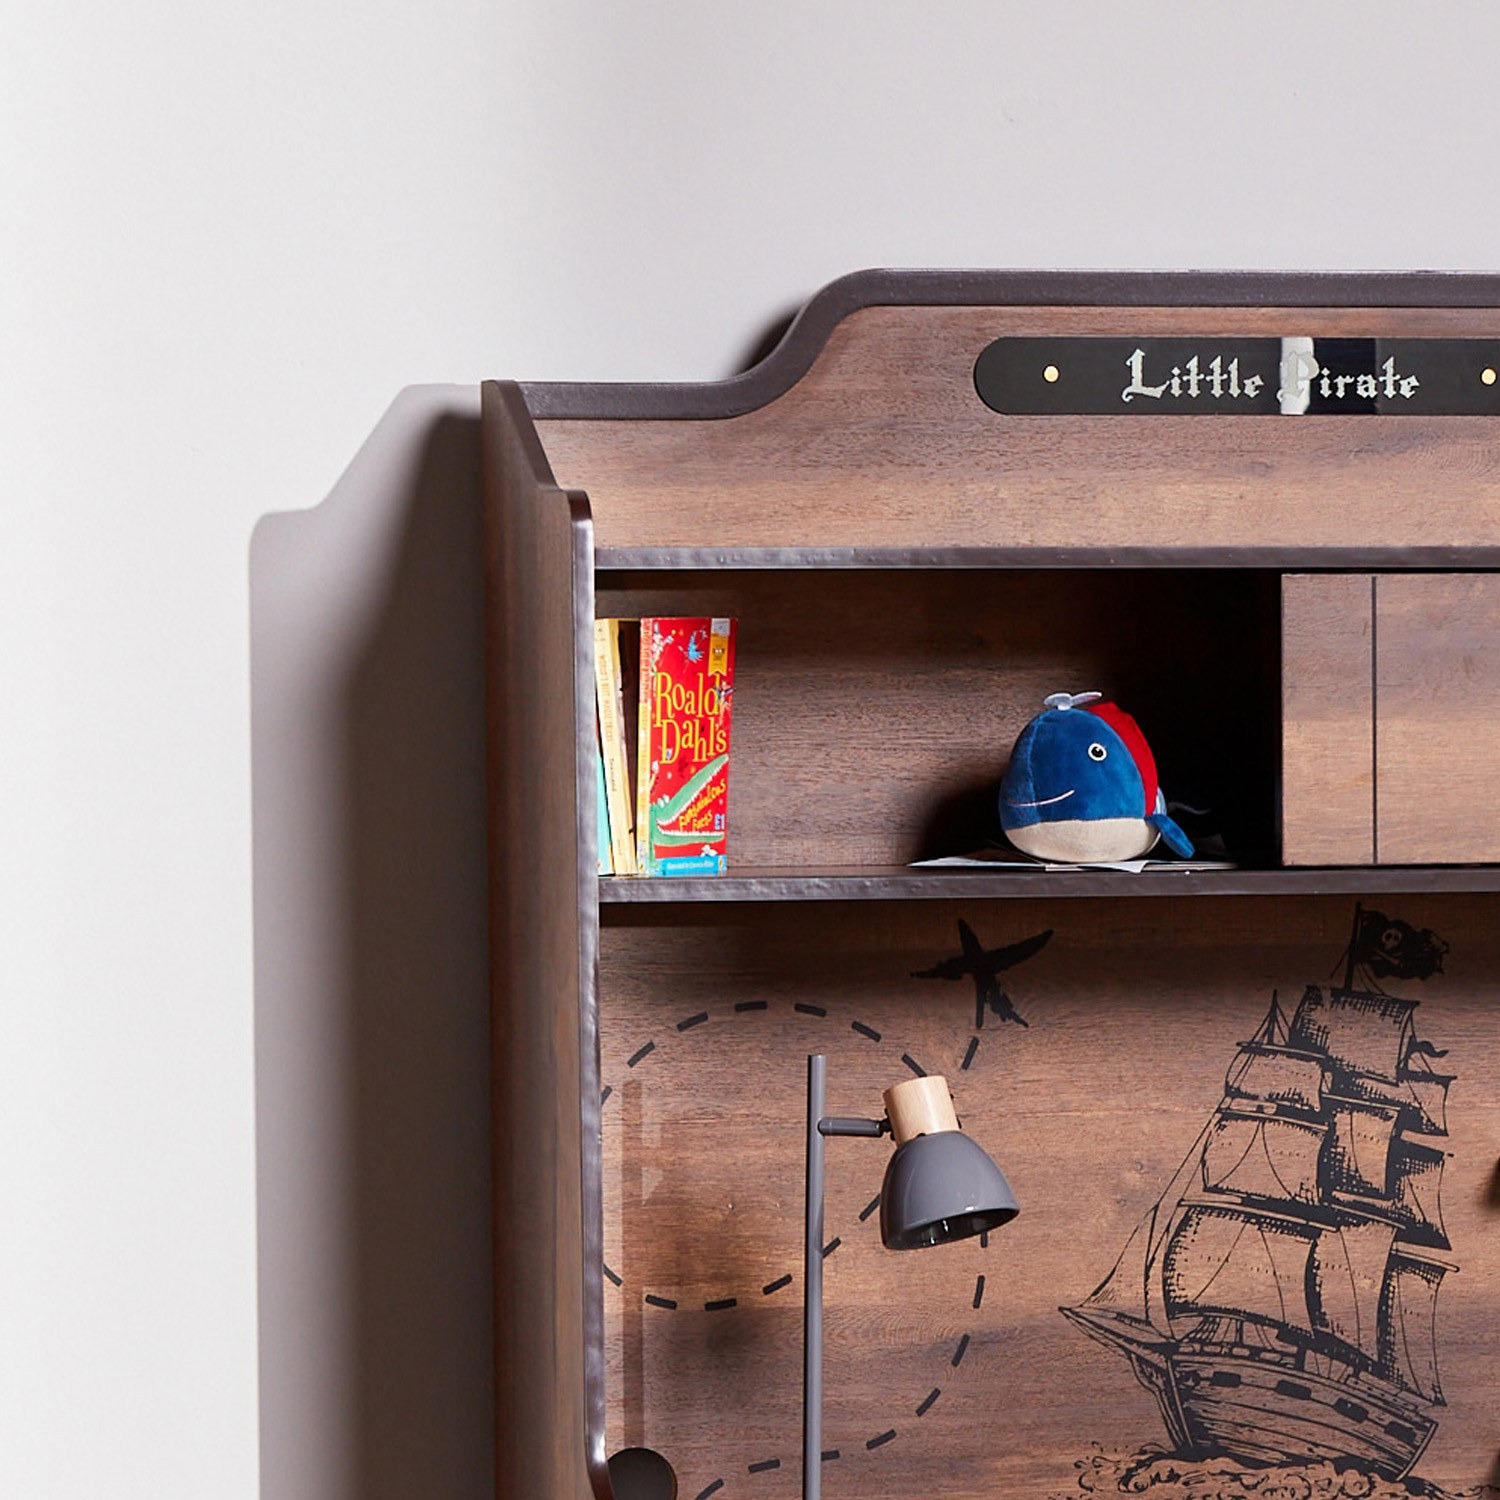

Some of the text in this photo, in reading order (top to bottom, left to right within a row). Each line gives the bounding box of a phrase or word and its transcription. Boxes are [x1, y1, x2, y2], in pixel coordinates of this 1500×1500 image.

[1121, 347, 1421, 403] Little Pirate
[655, 671, 720, 728] Roald
[660, 716, 727, 764] Dahl's
